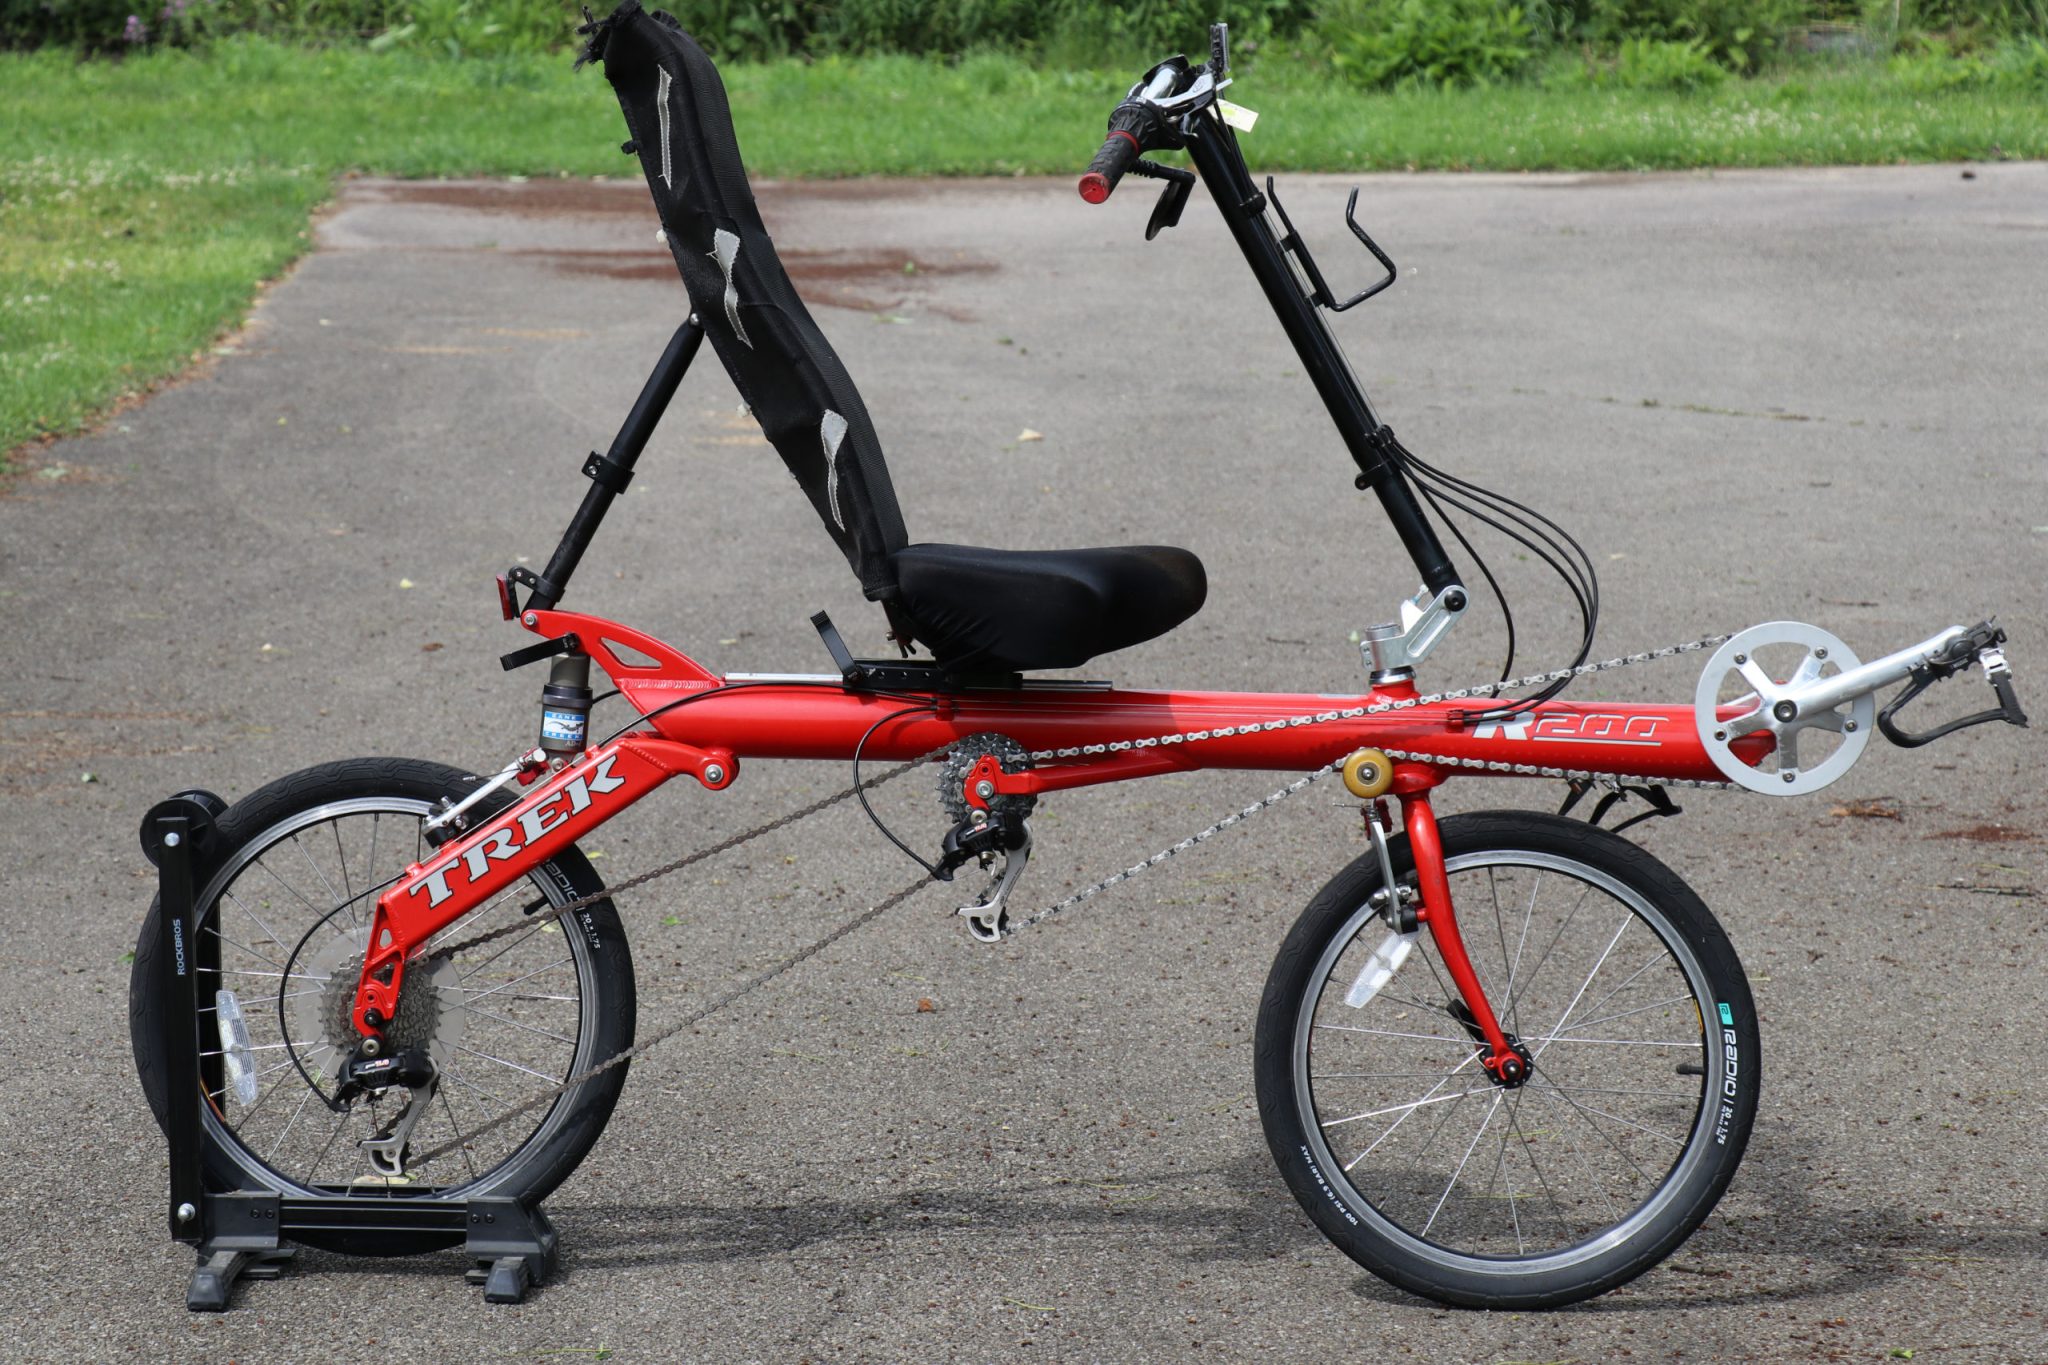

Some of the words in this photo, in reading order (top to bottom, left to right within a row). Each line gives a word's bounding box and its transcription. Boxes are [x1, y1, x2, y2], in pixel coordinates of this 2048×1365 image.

[1472, 709, 1670, 740] R200
[409, 754, 625, 909] TREK
[546, 861, 581, 903] ADIO
[172, 918, 186, 976] ROCKBROS
[1300, 1144, 1313, 1164] MAX
[1333, 1199, 1347, 1214] PSI
[1345, 1212, 1359, 1226] 100
